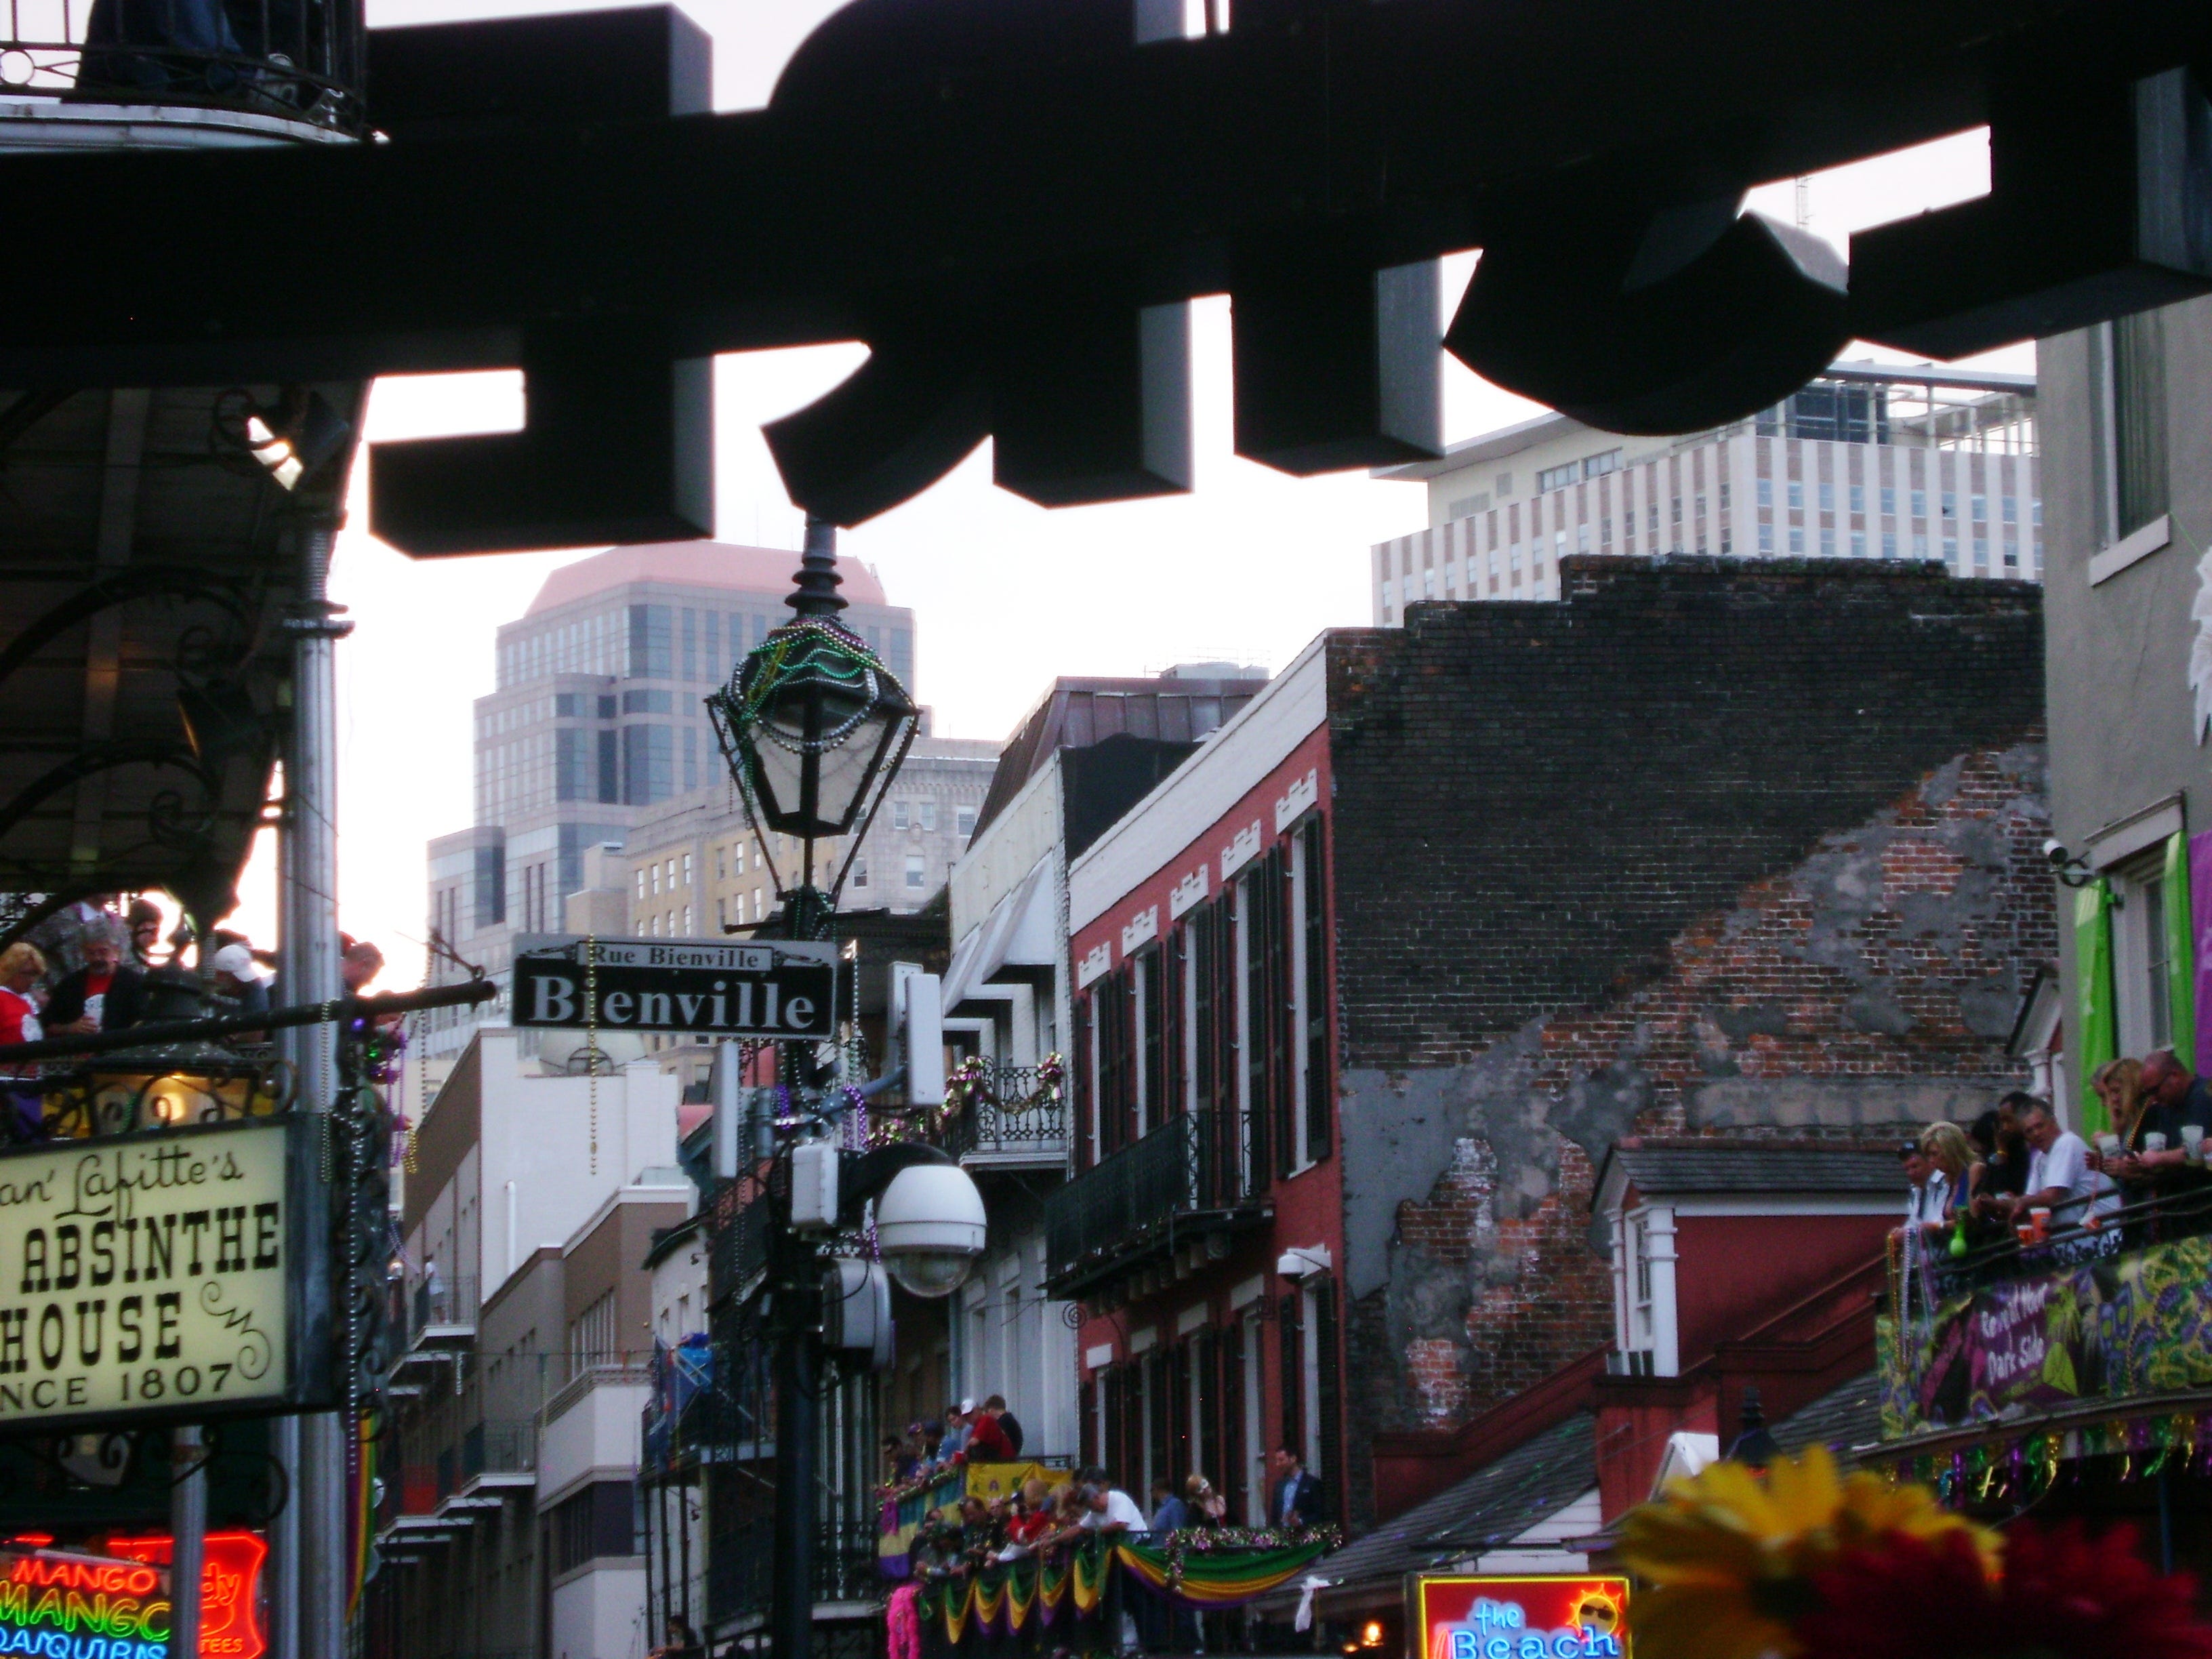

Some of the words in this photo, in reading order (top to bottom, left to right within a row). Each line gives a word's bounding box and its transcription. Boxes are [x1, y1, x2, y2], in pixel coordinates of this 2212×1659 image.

[591, 947, 636, 965] Rue
[649, 947, 759, 968] Bienville
[529, 975, 815, 1030] Bienville
[54, 1145, 244, 1228] Lafitte's
[20, 1202, 279, 1294] ABSINTHE
[0, 1292, 181, 1374] HOUSE
[121, 1363, 233, 1401] 1807
[13, 1559, 156, 1592] MANGO
[1475, 1603, 1519, 1636] the
[1452, 1624, 1619, 1659] Beach
